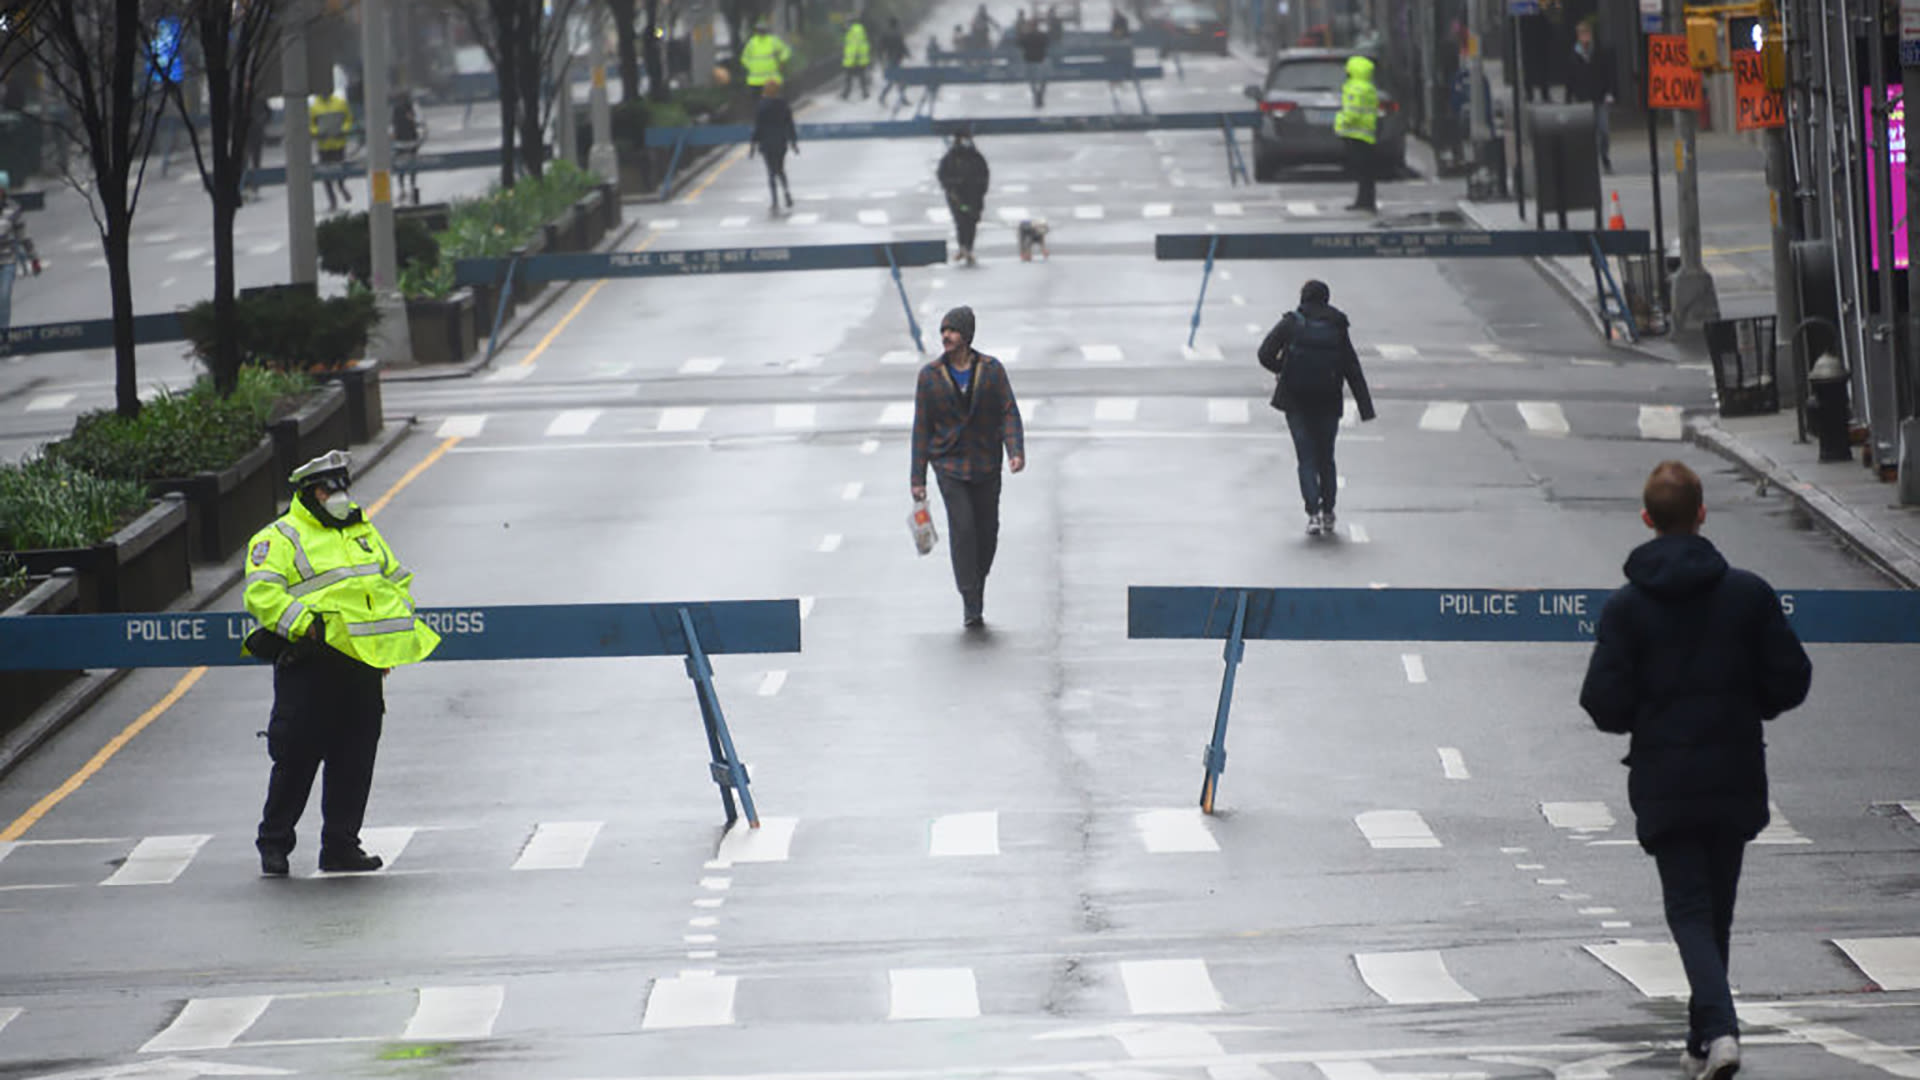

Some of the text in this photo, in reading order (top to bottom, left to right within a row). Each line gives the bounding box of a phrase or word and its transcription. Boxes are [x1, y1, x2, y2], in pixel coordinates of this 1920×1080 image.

[1652, 41, 1690, 66] RAIS
[1652, 76, 1696, 101] PLOW
[609, 254, 649, 266] POLICE
[659, 252, 686, 265] LINE
[1438, 594, 1588, 615] POLICE LINE
[126, 618, 207, 641] POLICE
